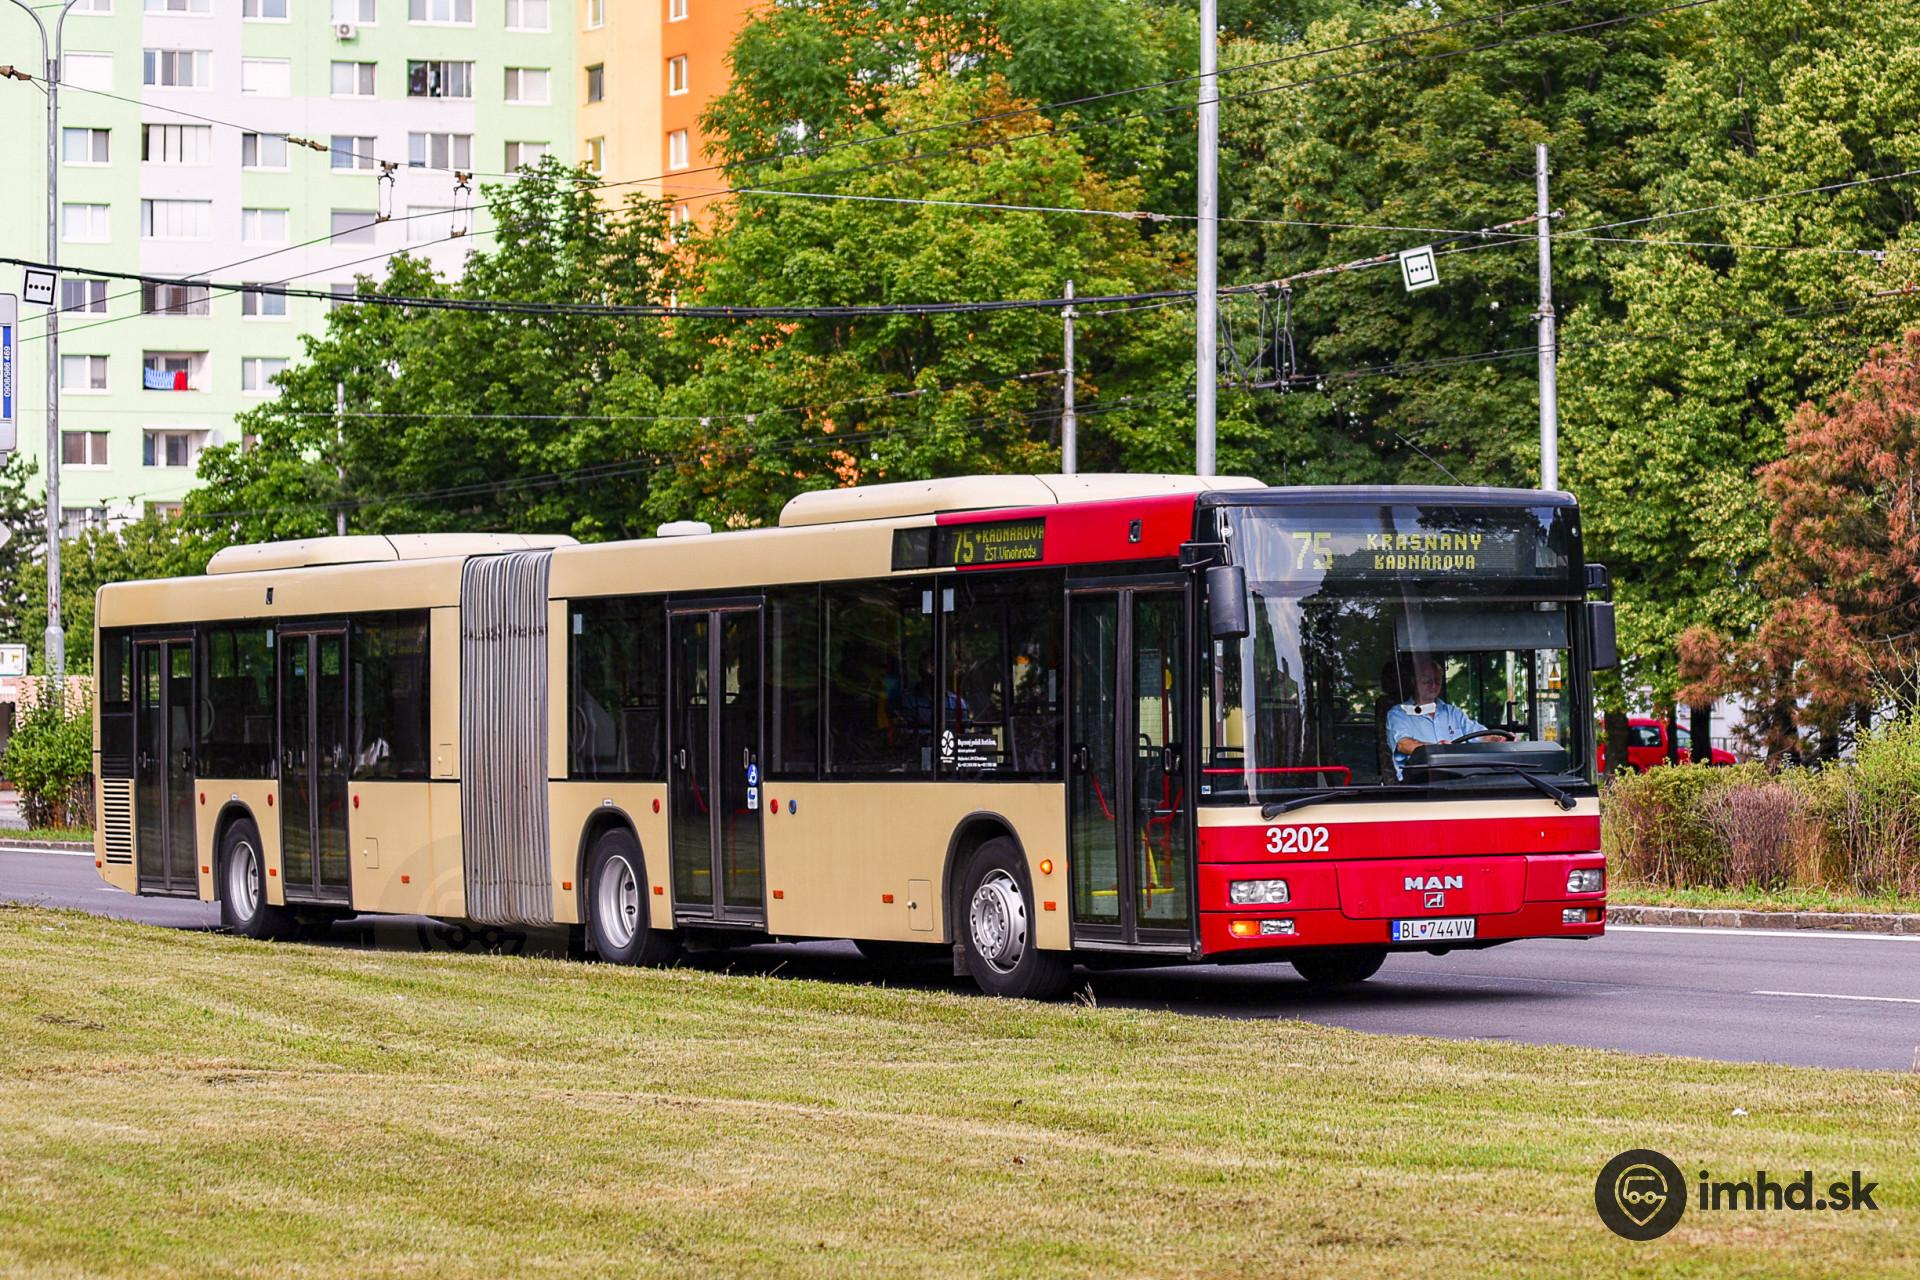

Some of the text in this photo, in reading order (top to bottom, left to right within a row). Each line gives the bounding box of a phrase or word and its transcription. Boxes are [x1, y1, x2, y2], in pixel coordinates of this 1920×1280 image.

[952, 530, 974, 563] 75
[1292, 532, 1334, 570] 75
[1265, 826, 1330, 854] 3202
[1404, 875, 1463, 891] MAN
[1402, 920, 1472, 939] BL 744VV
